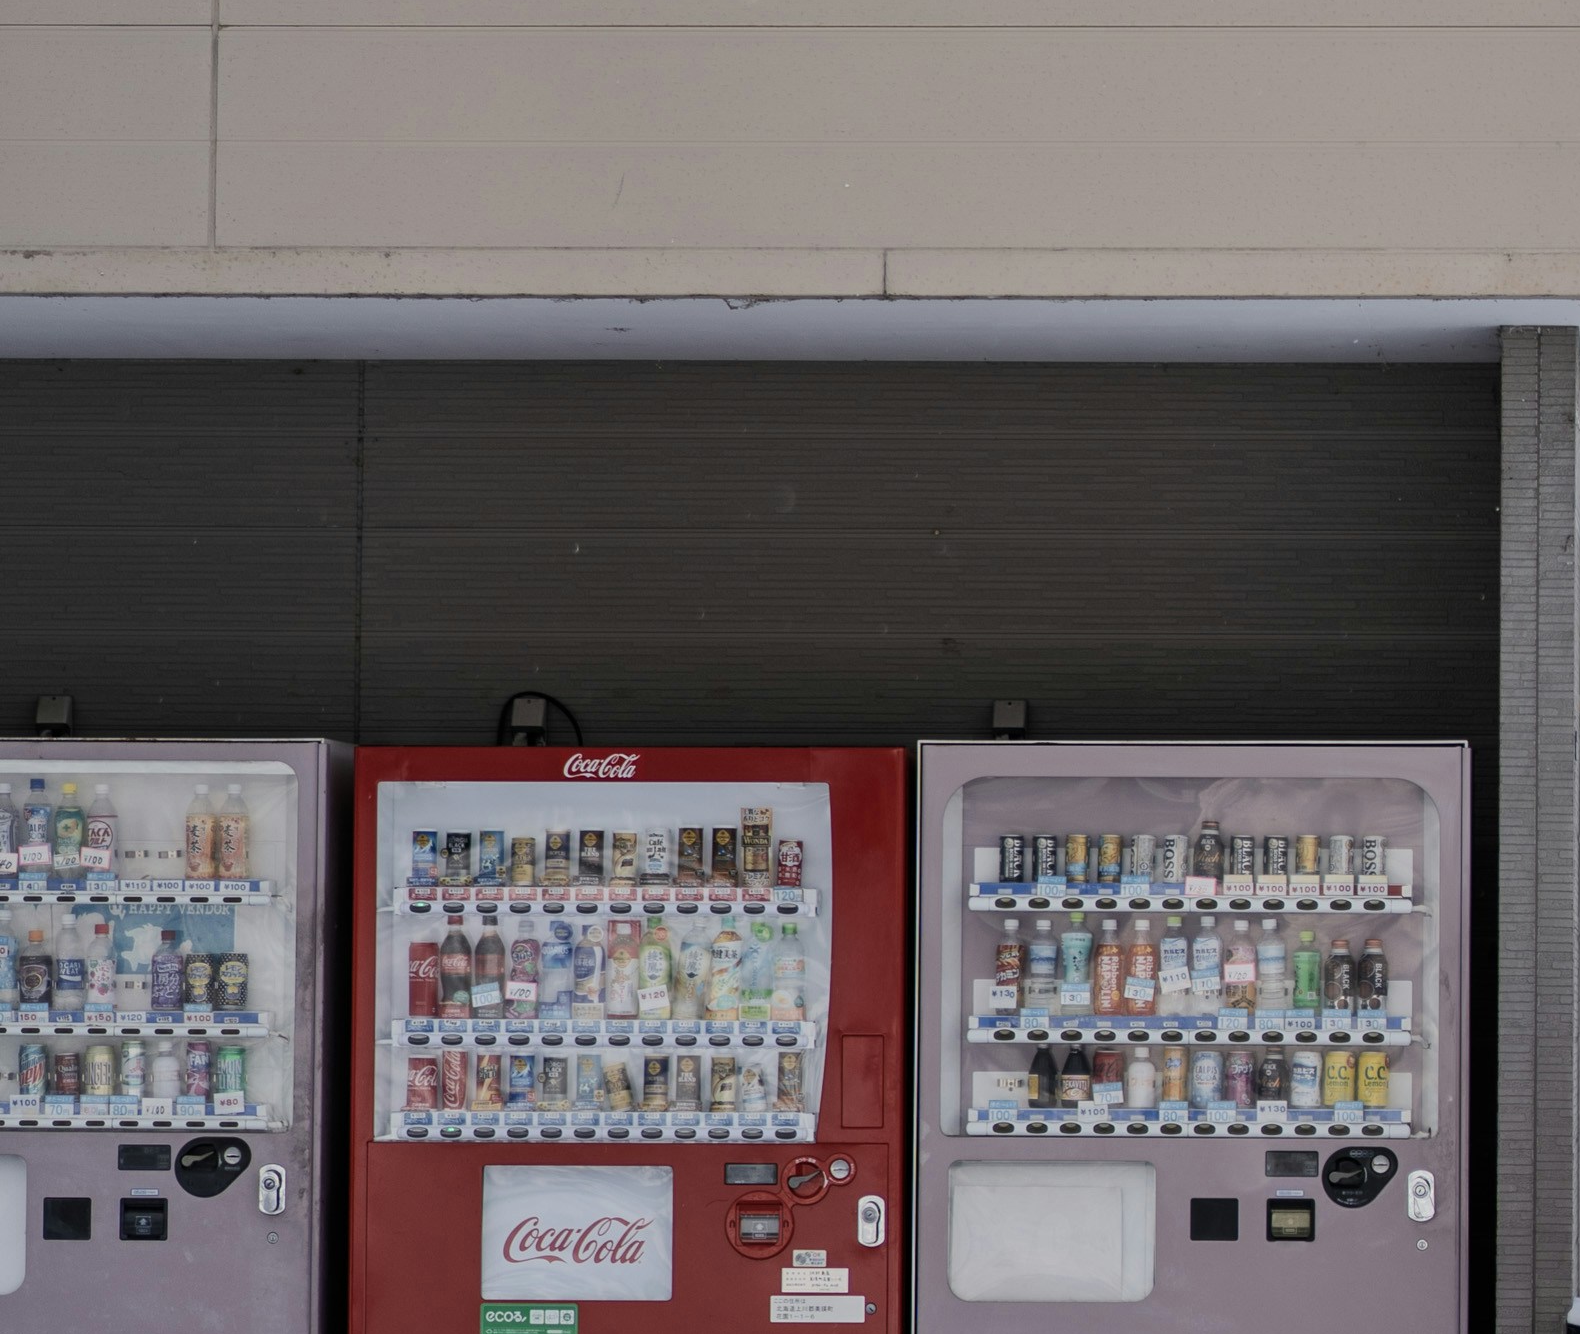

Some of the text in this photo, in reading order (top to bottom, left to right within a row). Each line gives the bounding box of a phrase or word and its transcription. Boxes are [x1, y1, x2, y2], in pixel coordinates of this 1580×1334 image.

[563, 753, 640, 778] Coca-Cola
[190, 824, 202, 853] 麦茶
[223, 824, 236, 853] 麦茶
[744, 836, 768, 845] WONDA
[84, 854, 103, 865] ¥100
[781, 851, 800, 863] 甘酒
[1164, 838, 1175, 879] BOSS
[188, 882, 211, 890] ¥100
[224, 883, 246, 891] ¥100
[128, 904, 230, 915] HAPPY VENDOR
[1111, 956, 1119, 990] Ribbon
[1162, 972, 1187, 983] ¥110
[1342, 964, 1350, 989] BLACK
[510, 987, 531, 998] ¥100
[641, 990, 665, 1000] ¥120
[992, 989, 1015, 999] ¥130
[87, 1013, 112, 1022] ¥150
[1327, 1066, 1350, 1079] C.C.
[1364, 1079, 1388, 1087] Lemon
[220, 1098, 239, 1106] ¥80
[502, 1216, 655, 1265] Coca-Cola
